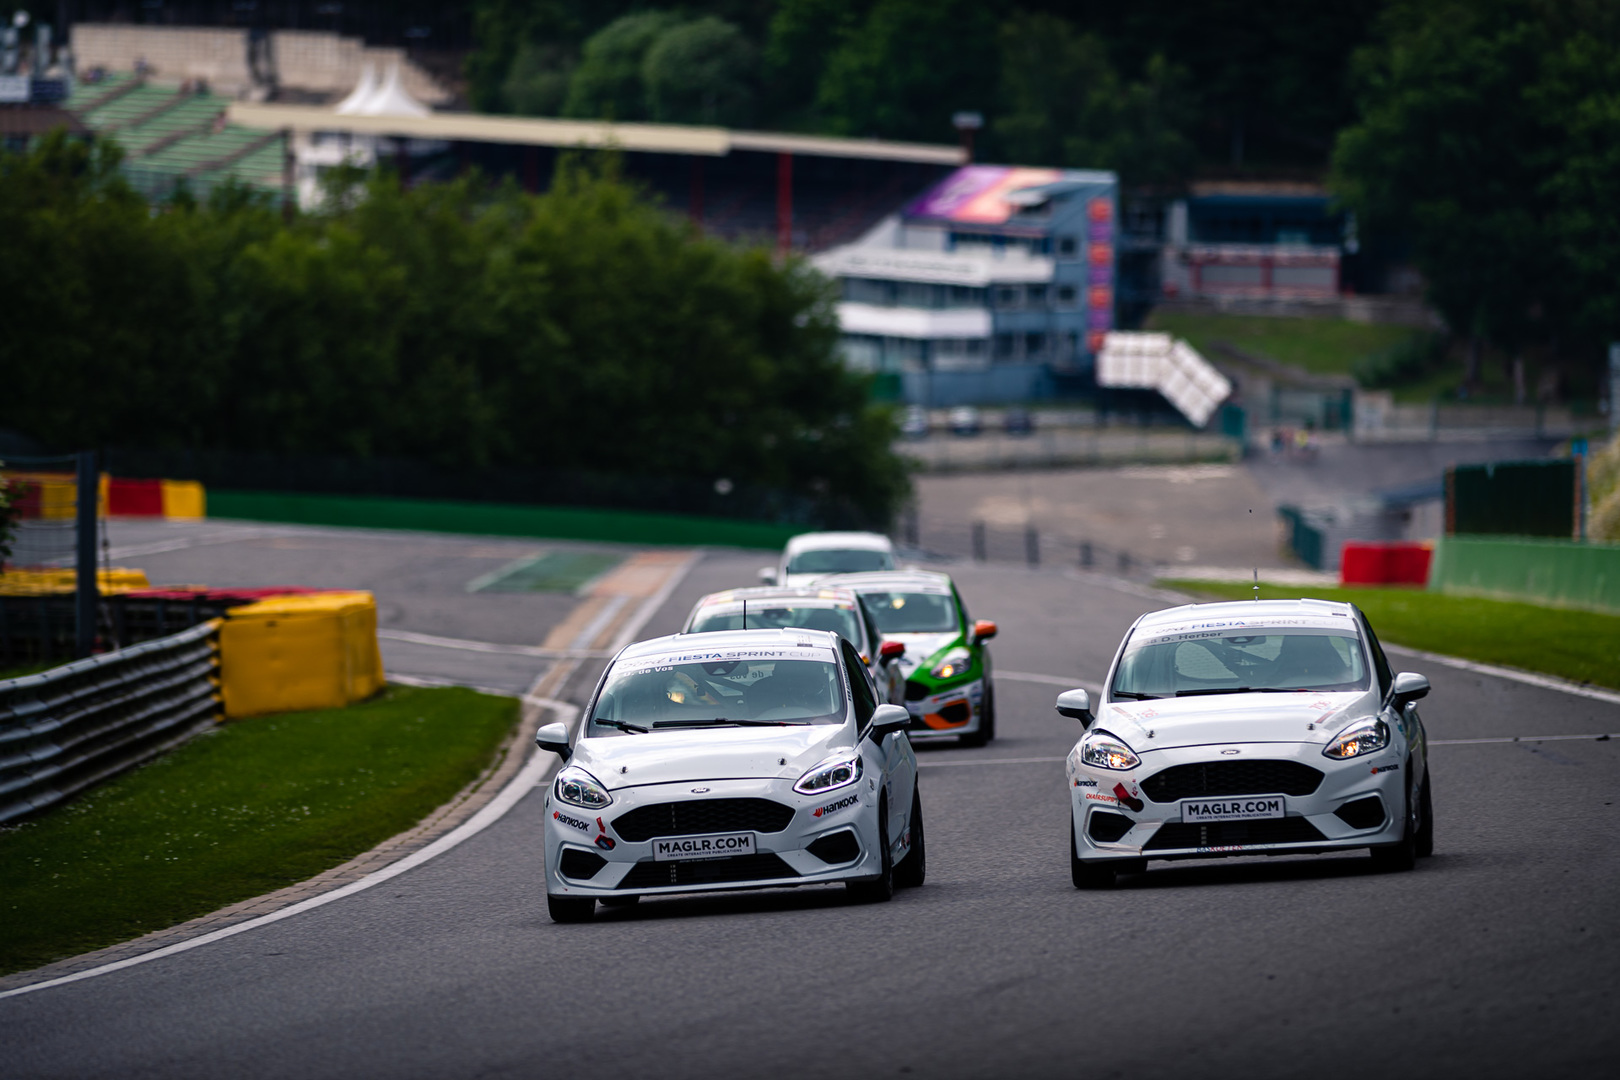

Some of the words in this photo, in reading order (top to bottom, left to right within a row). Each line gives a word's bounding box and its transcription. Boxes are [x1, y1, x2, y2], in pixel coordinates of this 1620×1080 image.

[1191, 620, 1246, 630] FIESTA
[1178, 631, 1223, 641] Herber
[668, 652, 722, 663] FIESTA
[726, 650, 786, 658] SPRINT
[1188, 800, 1279, 816] MAGLR.COM
[658, 836, 750, 854] MAGLR.COM
